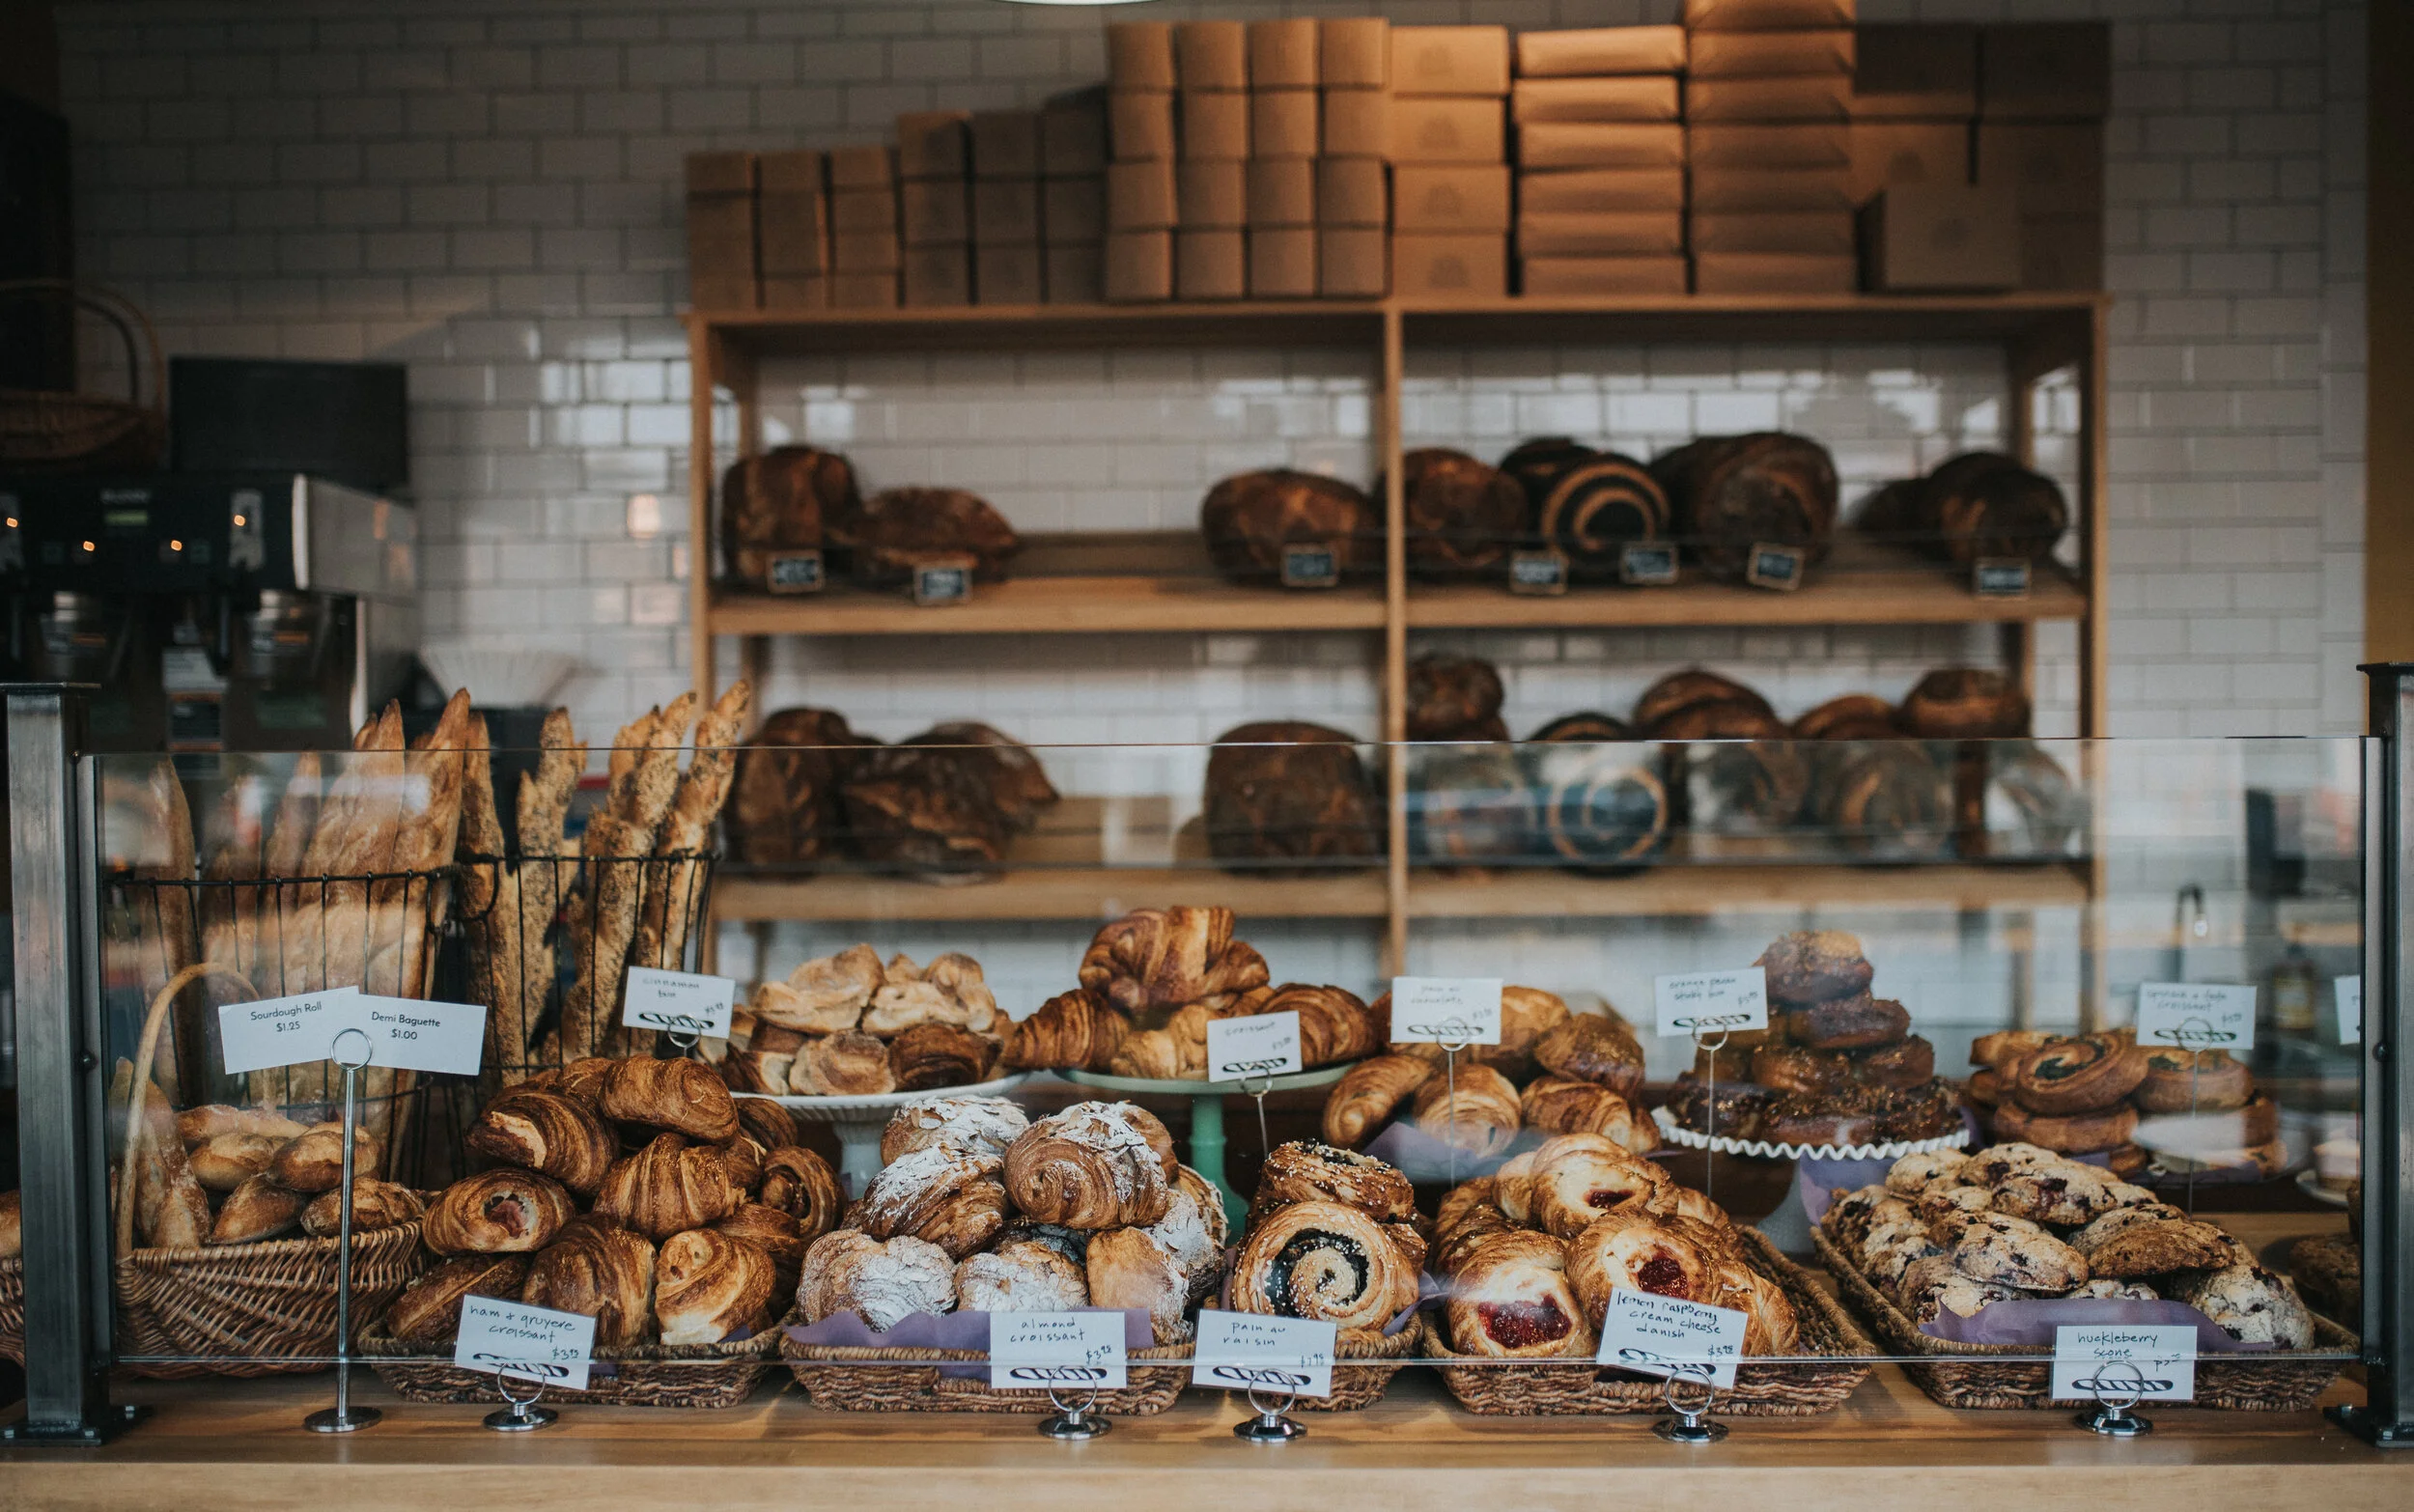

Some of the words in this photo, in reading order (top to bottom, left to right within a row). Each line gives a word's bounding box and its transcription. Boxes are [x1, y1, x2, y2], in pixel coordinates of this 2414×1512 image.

[250, 1004, 302, 1022] Sourdough
[304, 1000, 322, 1013] Roll
[275, 1021, 300, 1032] $1.25
[371, 1012, 397, 1023] Demi
[398, 1014, 441, 1028] Baguette
[391, 1028, 418, 1041] $1.00
[1616, 1291, 1655, 1308] lemon
[470, 1305, 500, 1318] ham
[520, 1314, 576, 1332] gruyere
[1021, 1317, 1077, 1330] almond
[1629, 1310, 1673, 1325] cream
[1680, 1318, 1722, 1334] cheese
[489, 1325, 556, 1343] croissant
[1010, 1329, 1085, 1343] croissant
[1636, 1323, 1686, 1339] danish
[2077, 1330, 2158, 1348] huckleberry
[1222, 1336, 1276, 1347] raisin
[2093, 1347, 2133, 1359] scone
